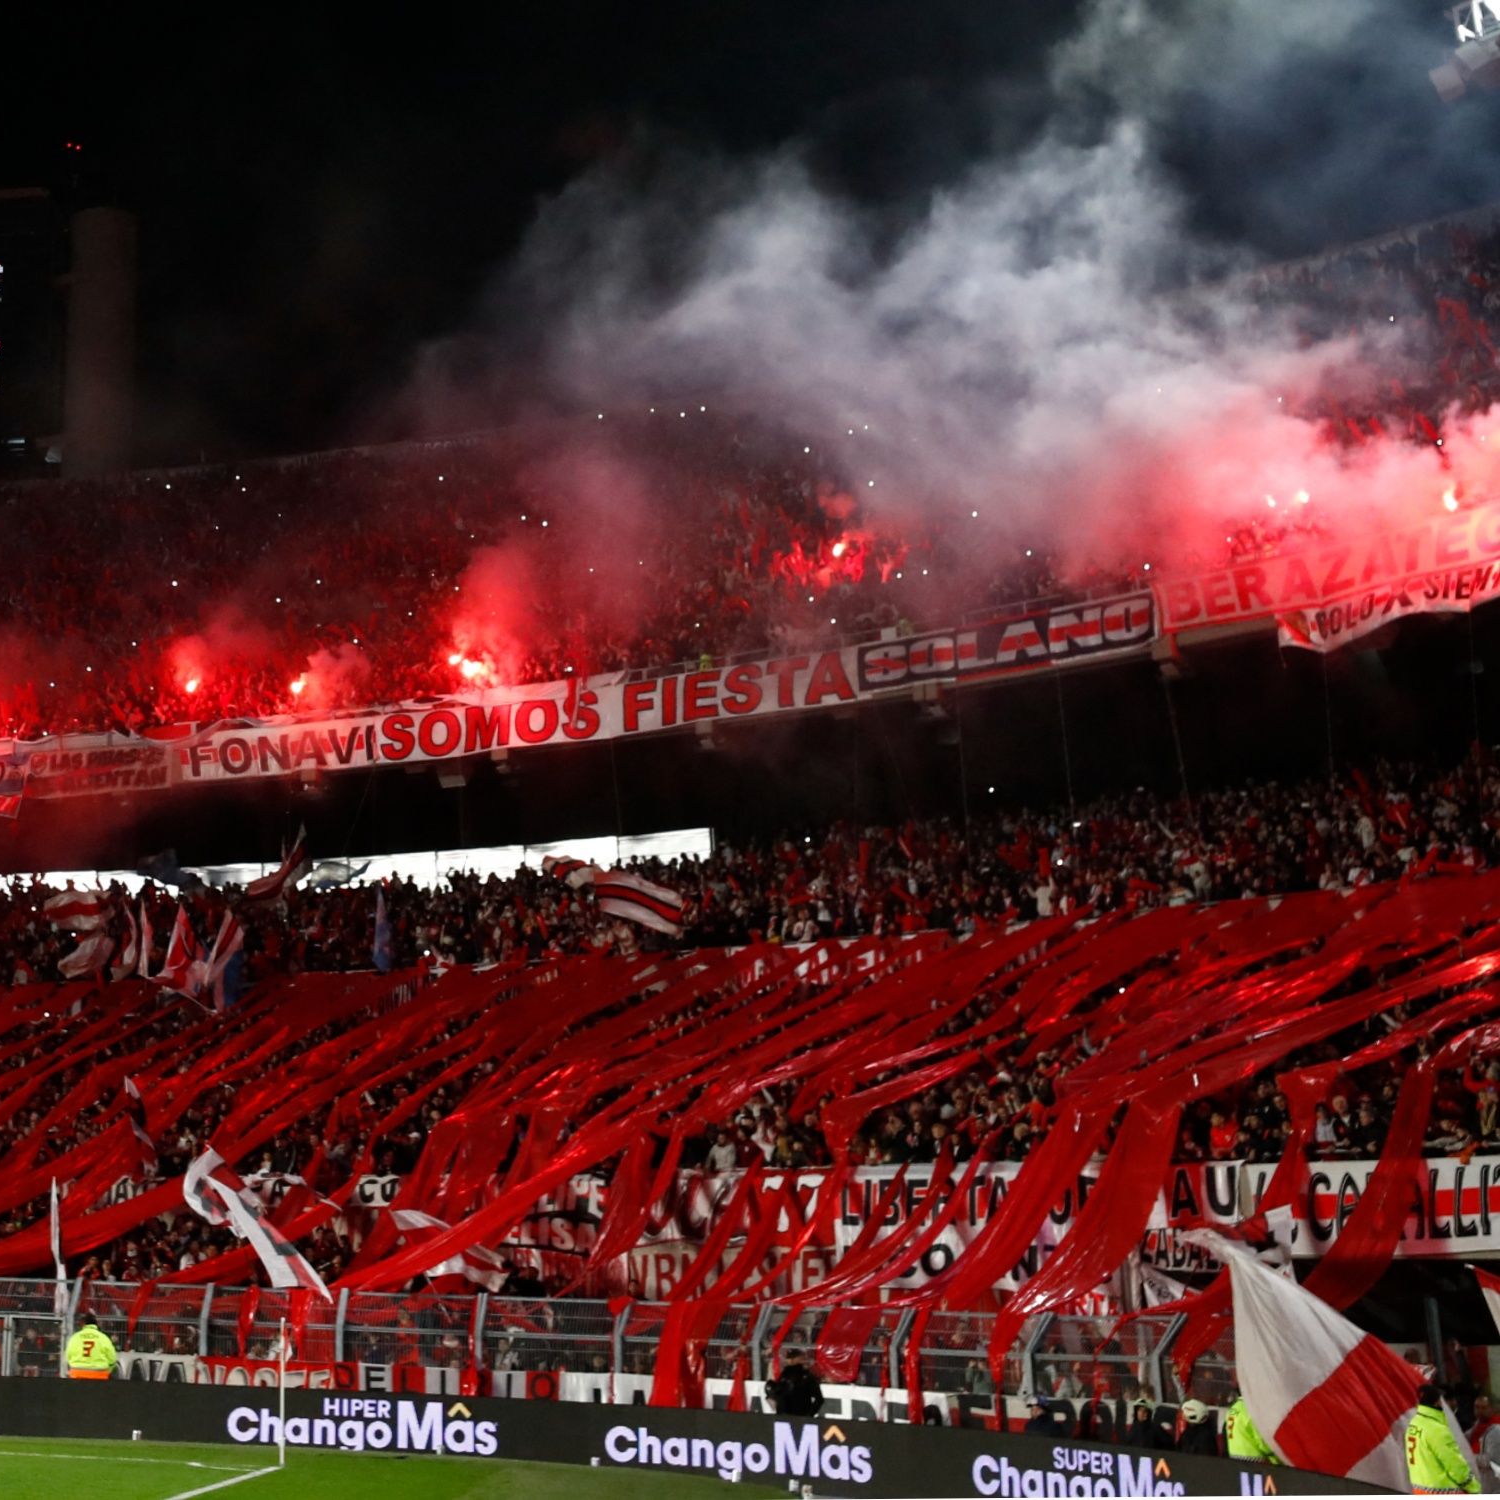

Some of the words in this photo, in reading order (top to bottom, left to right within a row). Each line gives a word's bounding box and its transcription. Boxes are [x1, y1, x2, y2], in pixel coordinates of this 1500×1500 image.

[863, 599, 1151, 684] SOLANO
[381, 692, 599, 760] SOMOS
[623, 650, 858, 732] FIESTA
[189, 725, 375, 777] FONAVI
[83, 1340, 95, 1358] 3
[323, 1397, 392, 1419] HIPER
[1052, 1446, 1114, 1476] SUPER
